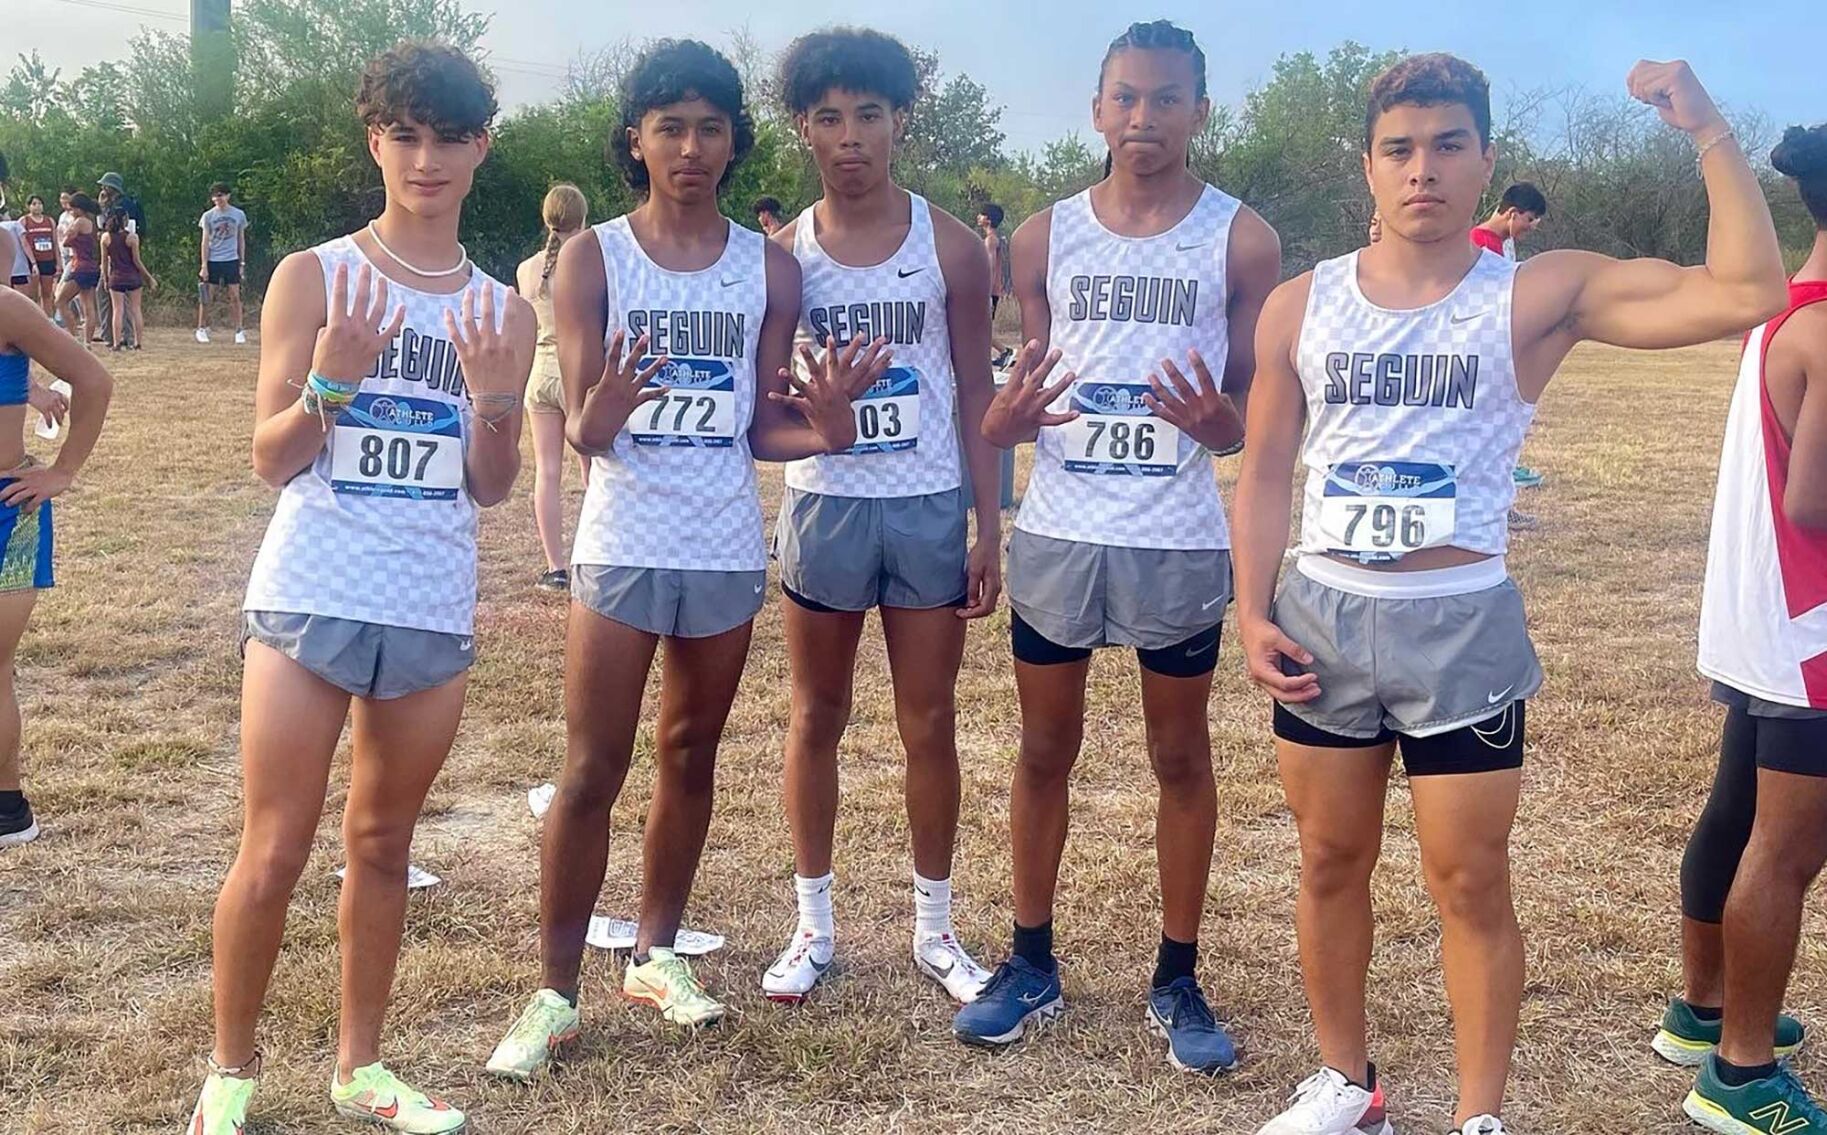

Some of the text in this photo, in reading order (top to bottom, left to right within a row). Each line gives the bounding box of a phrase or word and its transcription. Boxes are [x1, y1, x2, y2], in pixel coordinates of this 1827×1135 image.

[1069, 275, 1199, 327] SEGUIN
[628, 310, 745, 358] SEGUIN
[810, 301, 926, 348] SEGUIN
[366, 327, 473, 405] EGUI
[1324, 352, 1479, 409] SEGUIN
[389, 408, 434, 421] ATHLETE
[649, 395, 716, 432] 772
[359, 435, 439, 481] 807
[1085, 421, 1155, 461] 786
[1371, 473, 1422, 485] ATHLETE
[1344, 504, 1426, 548] 796
